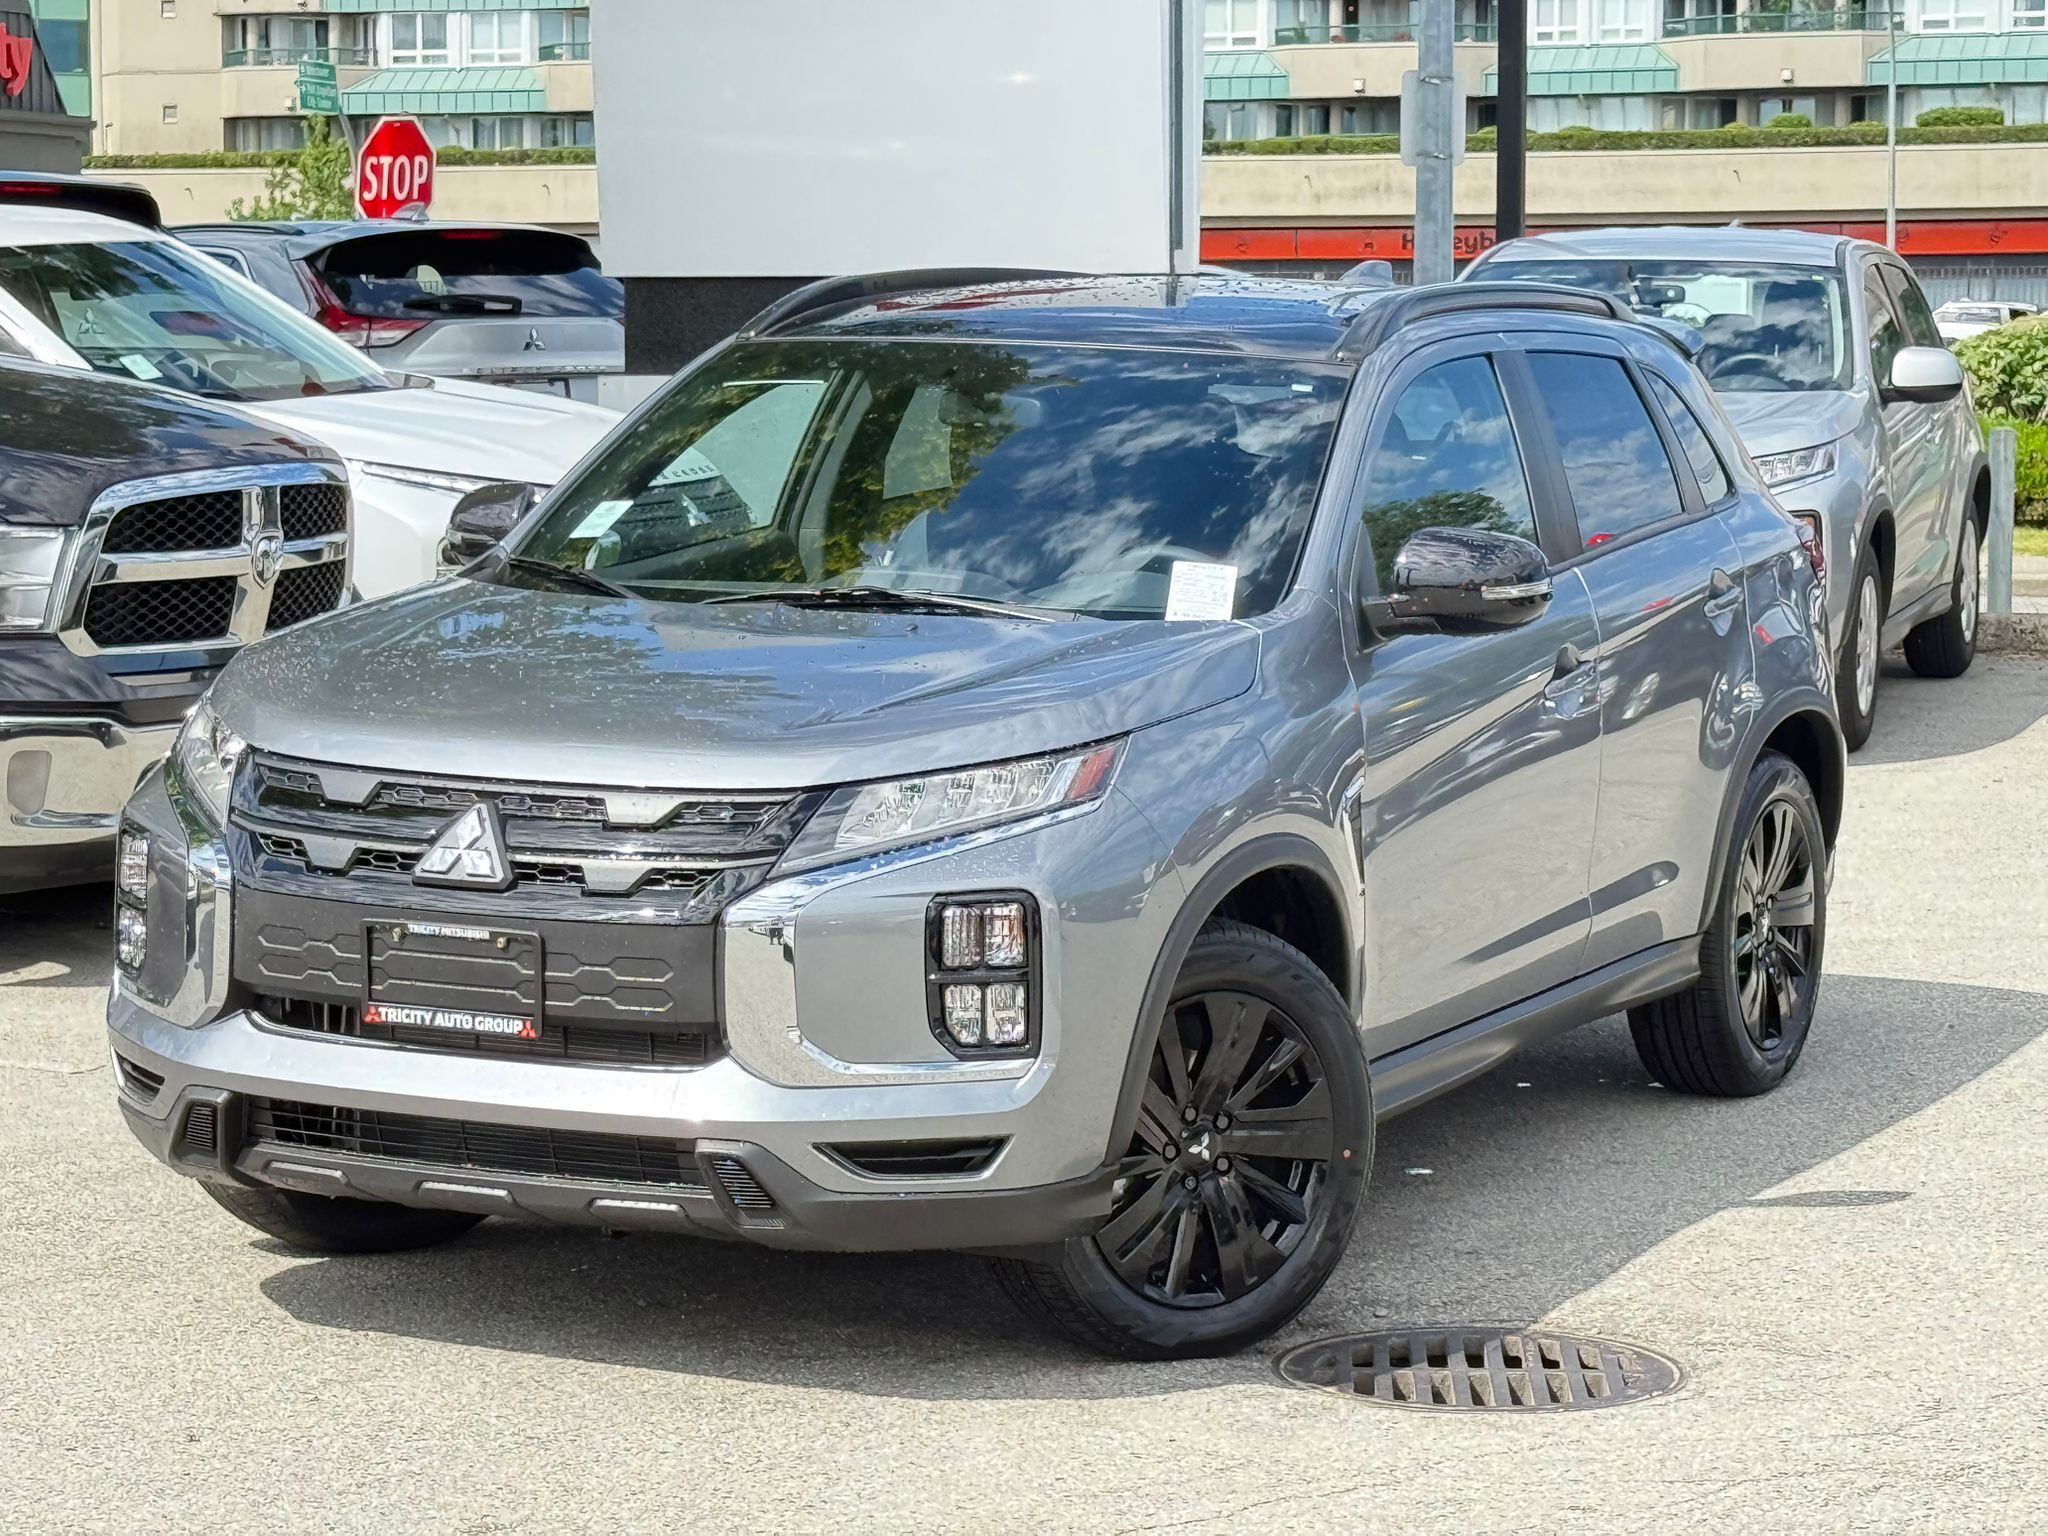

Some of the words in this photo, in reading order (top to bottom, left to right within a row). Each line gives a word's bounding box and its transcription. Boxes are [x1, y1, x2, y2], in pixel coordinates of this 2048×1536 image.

[362, 155, 429, 202] STOP
[378, 1006, 431, 1026] TRICITY
[434, 1012, 473, 1030] AUTO
[474, 1016, 524, 1035] GROUP
